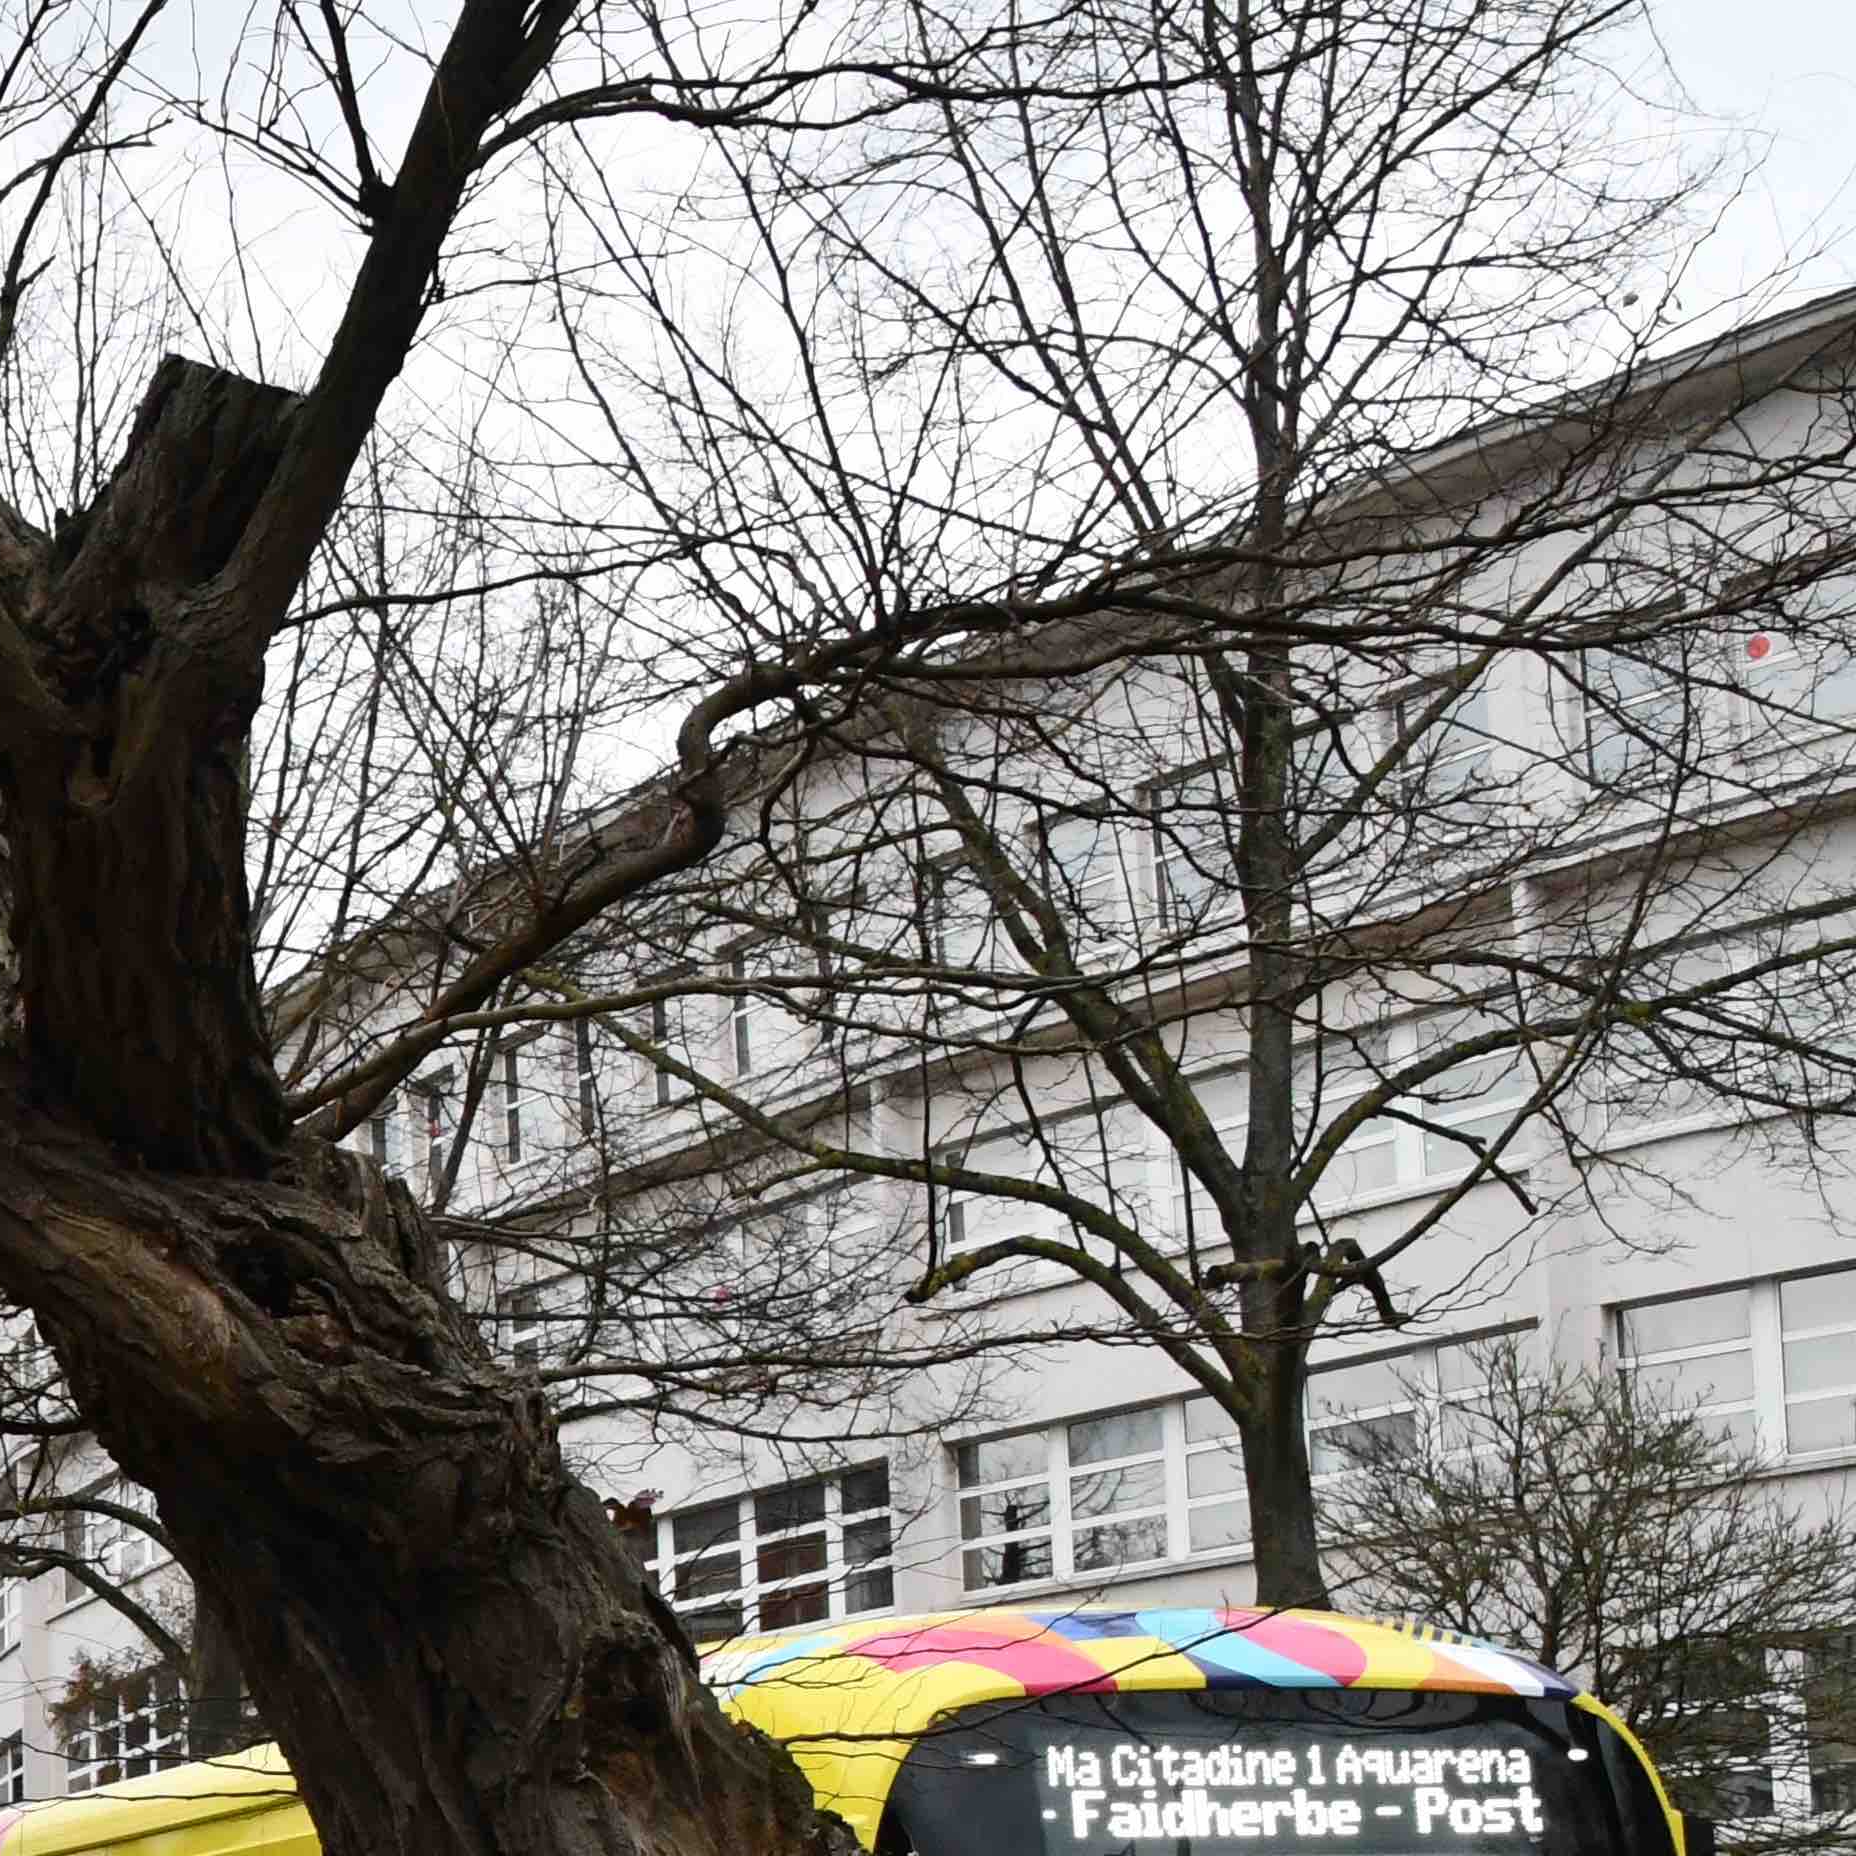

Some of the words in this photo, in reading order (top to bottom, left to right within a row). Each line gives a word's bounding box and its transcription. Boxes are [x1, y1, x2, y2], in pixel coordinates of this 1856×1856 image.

[1047, 1745, 1102, 1787] Ma
[1111, 1745, 1296, 1787] Citadine
[1307, 1744, 1326, 1785] 1
[1337, 1744, 1532, 1785] Aquarena
[1071, 1789, 1361, 1839] Faidherbe
[1414, 1786, 1544, 1834] Post
